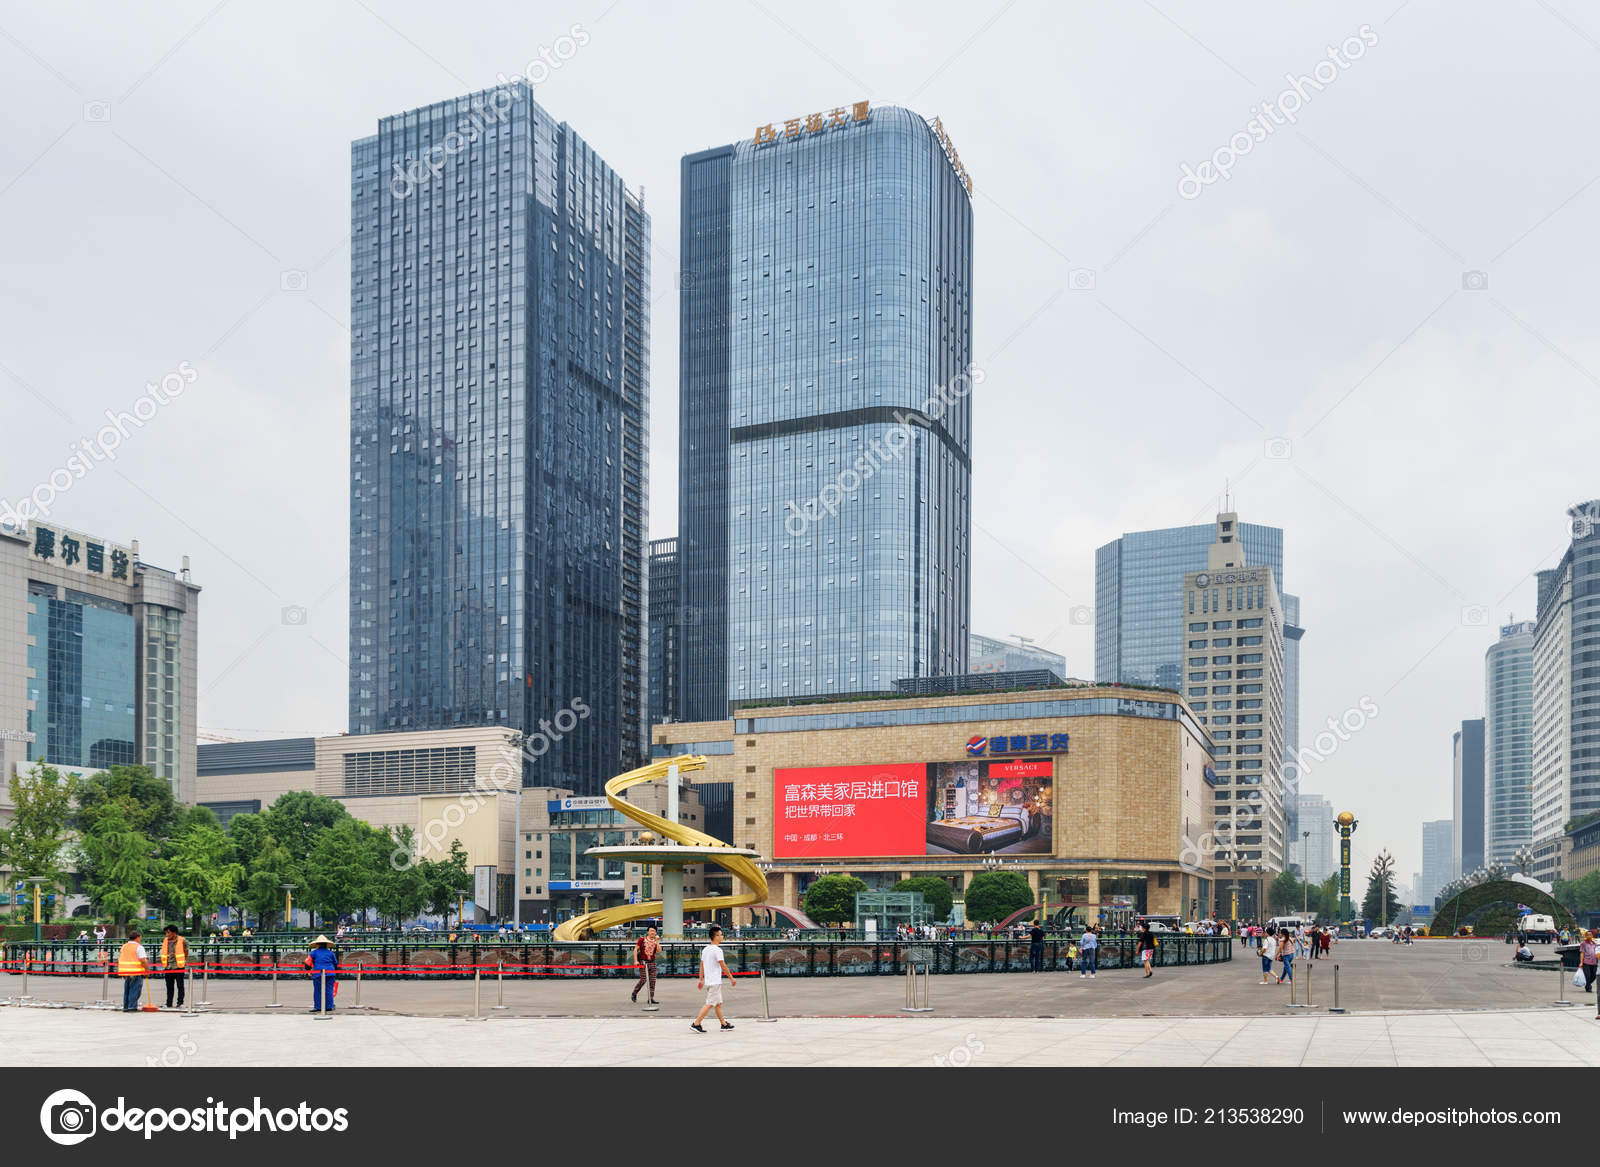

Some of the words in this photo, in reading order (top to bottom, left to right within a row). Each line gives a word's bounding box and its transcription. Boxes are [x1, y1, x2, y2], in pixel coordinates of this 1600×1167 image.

[784, 100, 869, 138] 百扬大厦
[34, 527, 129, 580] 摩尔百货
[784, 779, 919, 802] 富森美家居进口馆
[785, 804, 856, 818] 把世界带回家
